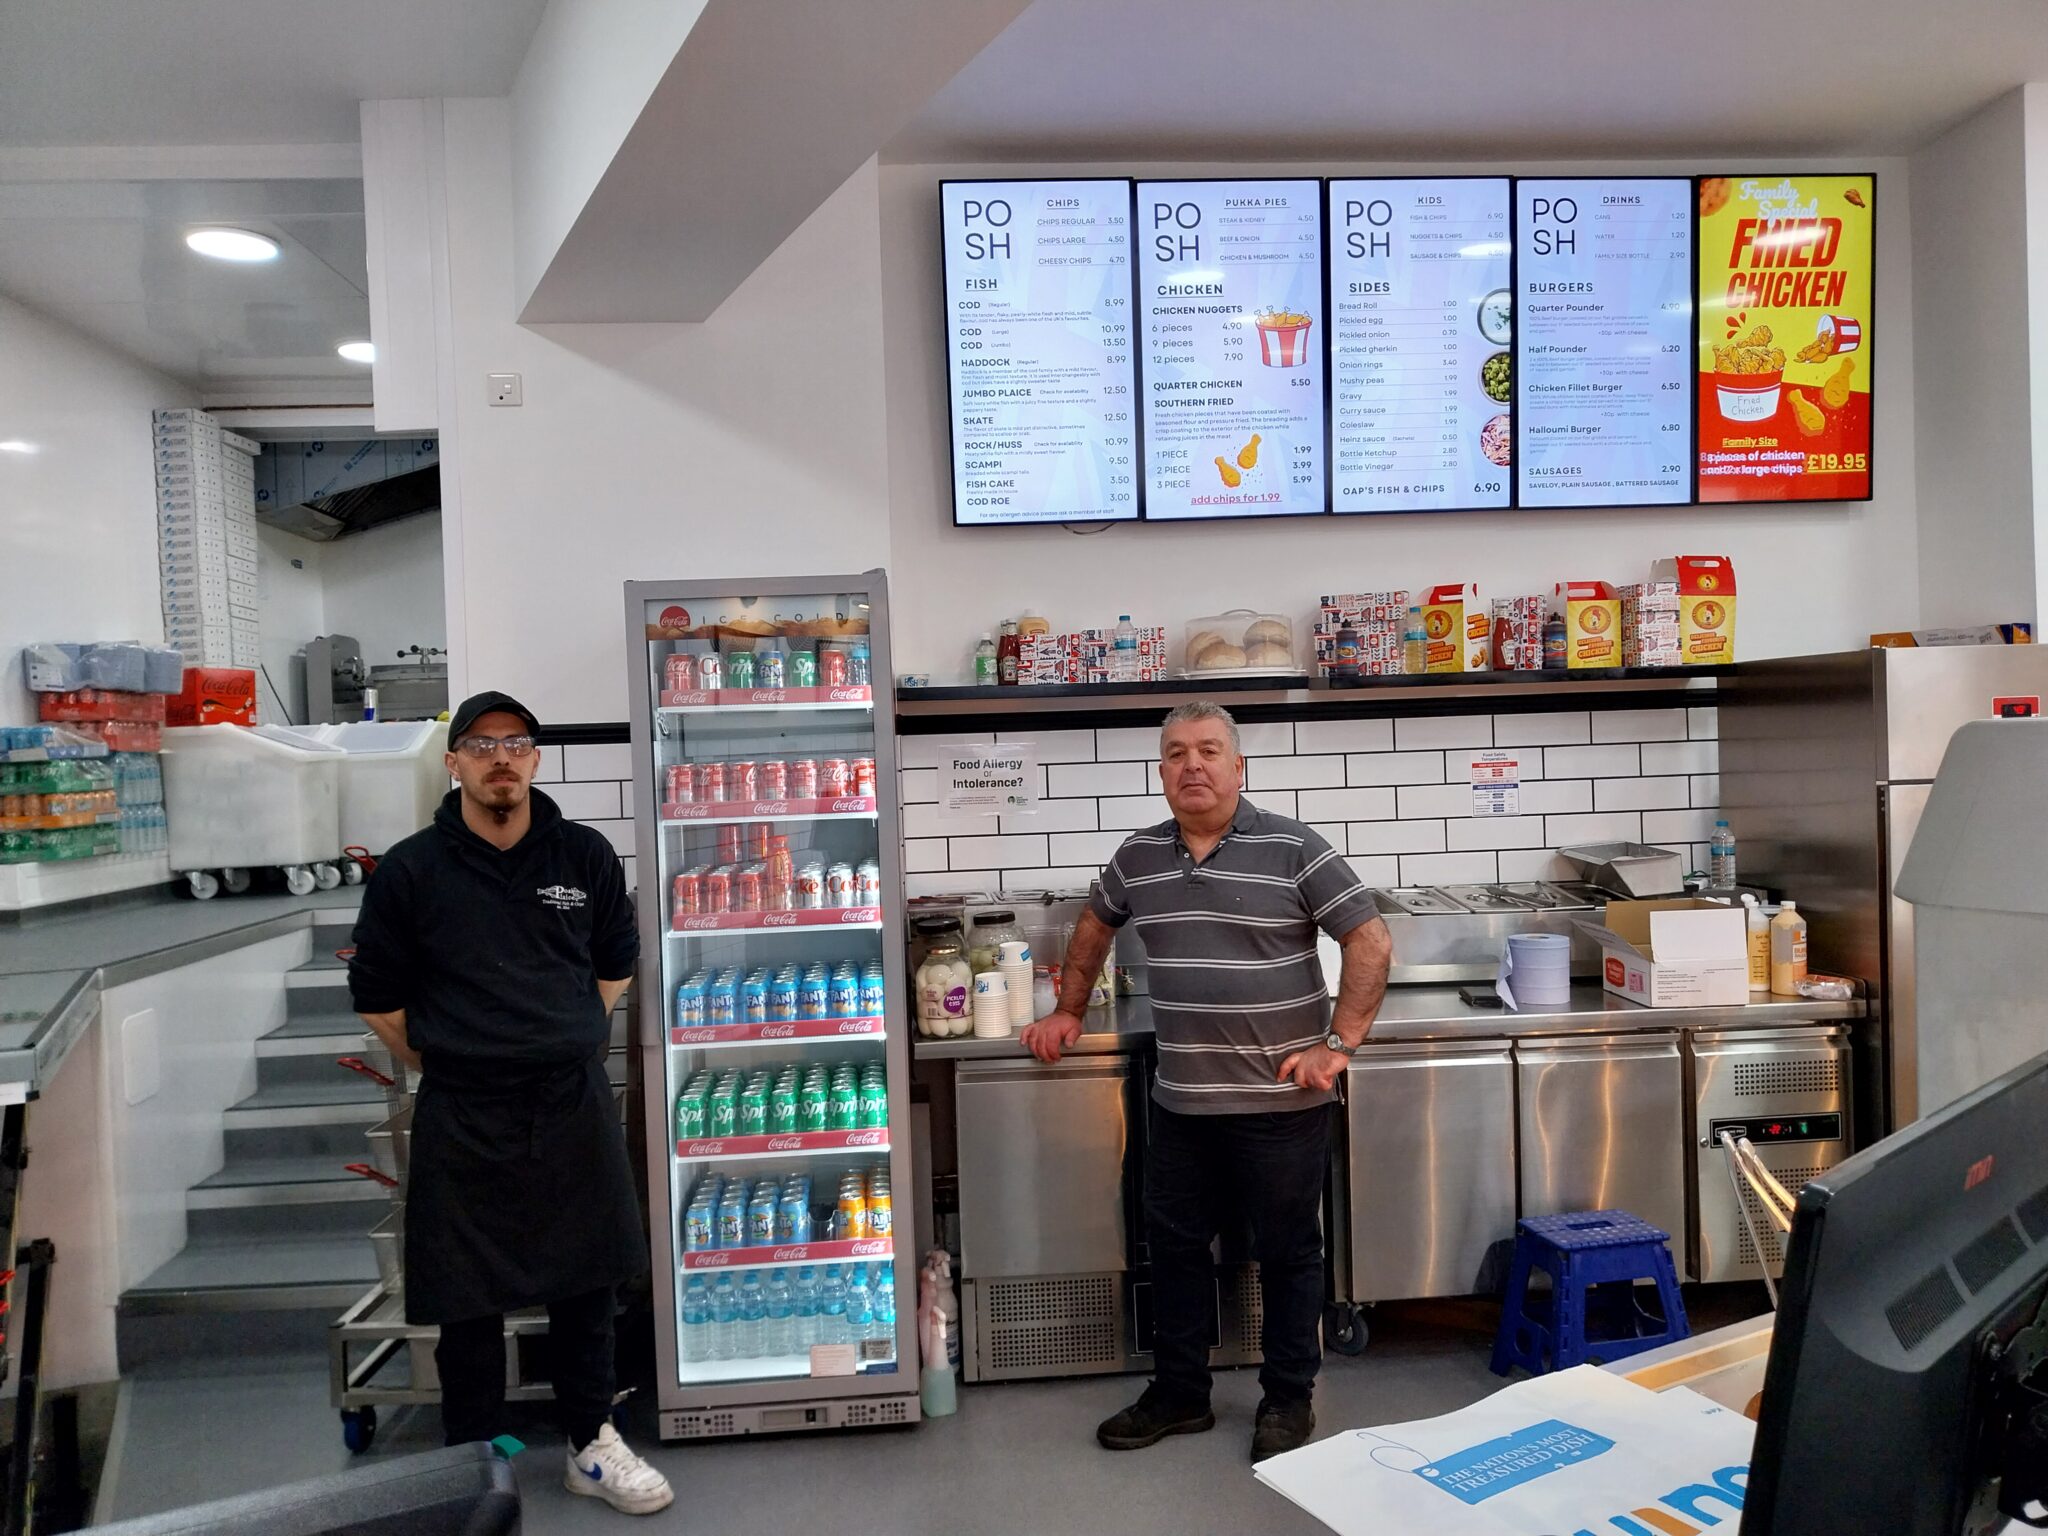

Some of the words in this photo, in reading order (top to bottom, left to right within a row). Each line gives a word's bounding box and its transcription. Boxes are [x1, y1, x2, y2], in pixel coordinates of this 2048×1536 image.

[1739, 179, 1798, 204] Family
[964, 200, 1011, 226] PO
[1346, 200, 1392, 226] PO
[1533, 198, 1577, 223] PO
[1758, 198, 1818, 228] Special
[1155, 203, 1201, 229] PO
[966, 233, 1010, 260] SH
[1347, 232, 1390, 258] SH
[1533, 230, 1575, 255] SH
[1155, 235, 1199, 262] SH
[966, 279, 997, 289] FISH
[1350, 283, 1390, 292] SIDES
[1530, 283, 1593, 292] BURGERS
[1158, 284, 1223, 295] CHICKEN
[1726, 271, 1847, 308] CHICKEN
[1105, 299, 1124, 307] 8.99
[1153, 307, 1195, 315] CHICKEN
[1198, 306, 1242, 314] NUGGETS
[1528, 305, 1563, 313] Quarter
[960, 328, 982, 336] COD
[1102, 325, 1125, 333] 10.99
[1162, 324, 1192, 333] pieces
[1223, 322, 1241, 330] 4.90
[1162, 340, 1193, 348] pieces
[1369, 345, 1397, 353] gherkin
[961, 358, 1010, 366] HADDOCK
[1165, 355, 1194, 364] pieces
[1364, 361, 1383, 369] rings
[1154, 382, 1198, 390] QUARTER
[1200, 380, 1242, 389] CHICKEN
[1529, 384, 1566, 392] Chicken
[1592, 384, 1622, 392] Burger
[963, 390, 995, 398] JUMBO
[999, 389, 1031, 397] PLAICE
[1104, 386, 1126, 394] 12.50
[1155, 399, 1205, 408] SOUTHERN
[1737, 396, 1760, 404] Fried
[1732, 406, 1764, 415] Chicken
[1105, 413, 1127, 421] 12.50
[1571, 426, 1601, 435] Burger
[965, 441, 1022, 450] ROCK/HUSS
[1722, 438, 1756, 448] Family
[1759, 437, 1778, 445] Size
[1162, 450, 1188, 458] PIECE
[965, 461, 1001, 469] SCAMPI
[1808, 453, 1865, 469] £19.95
[1529, 467, 1582, 475] SAUSAGES
[1165, 480, 1190, 488] PIECE
[1474, 483, 1500, 492] 6.90
[1191, 495, 1211, 504] add
[1213, 494, 1241, 504] chips
[1243, 493, 1258, 502] for
[1261, 493, 1280, 501] 1.99
[954, 760, 980, 769] Food
[983, 760, 1022, 769] Allergy
[954, 777, 1023, 788] Intolerance?
[1439, 1468, 1476, 1485] THE
[1472, 1442, 1539, 1474] NATION'S
[1538, 1429, 1578, 1446] MOST
[1452, 1451, 1552, 1492] TREASURED
[1549, 1434, 1595, 1453] DISH
